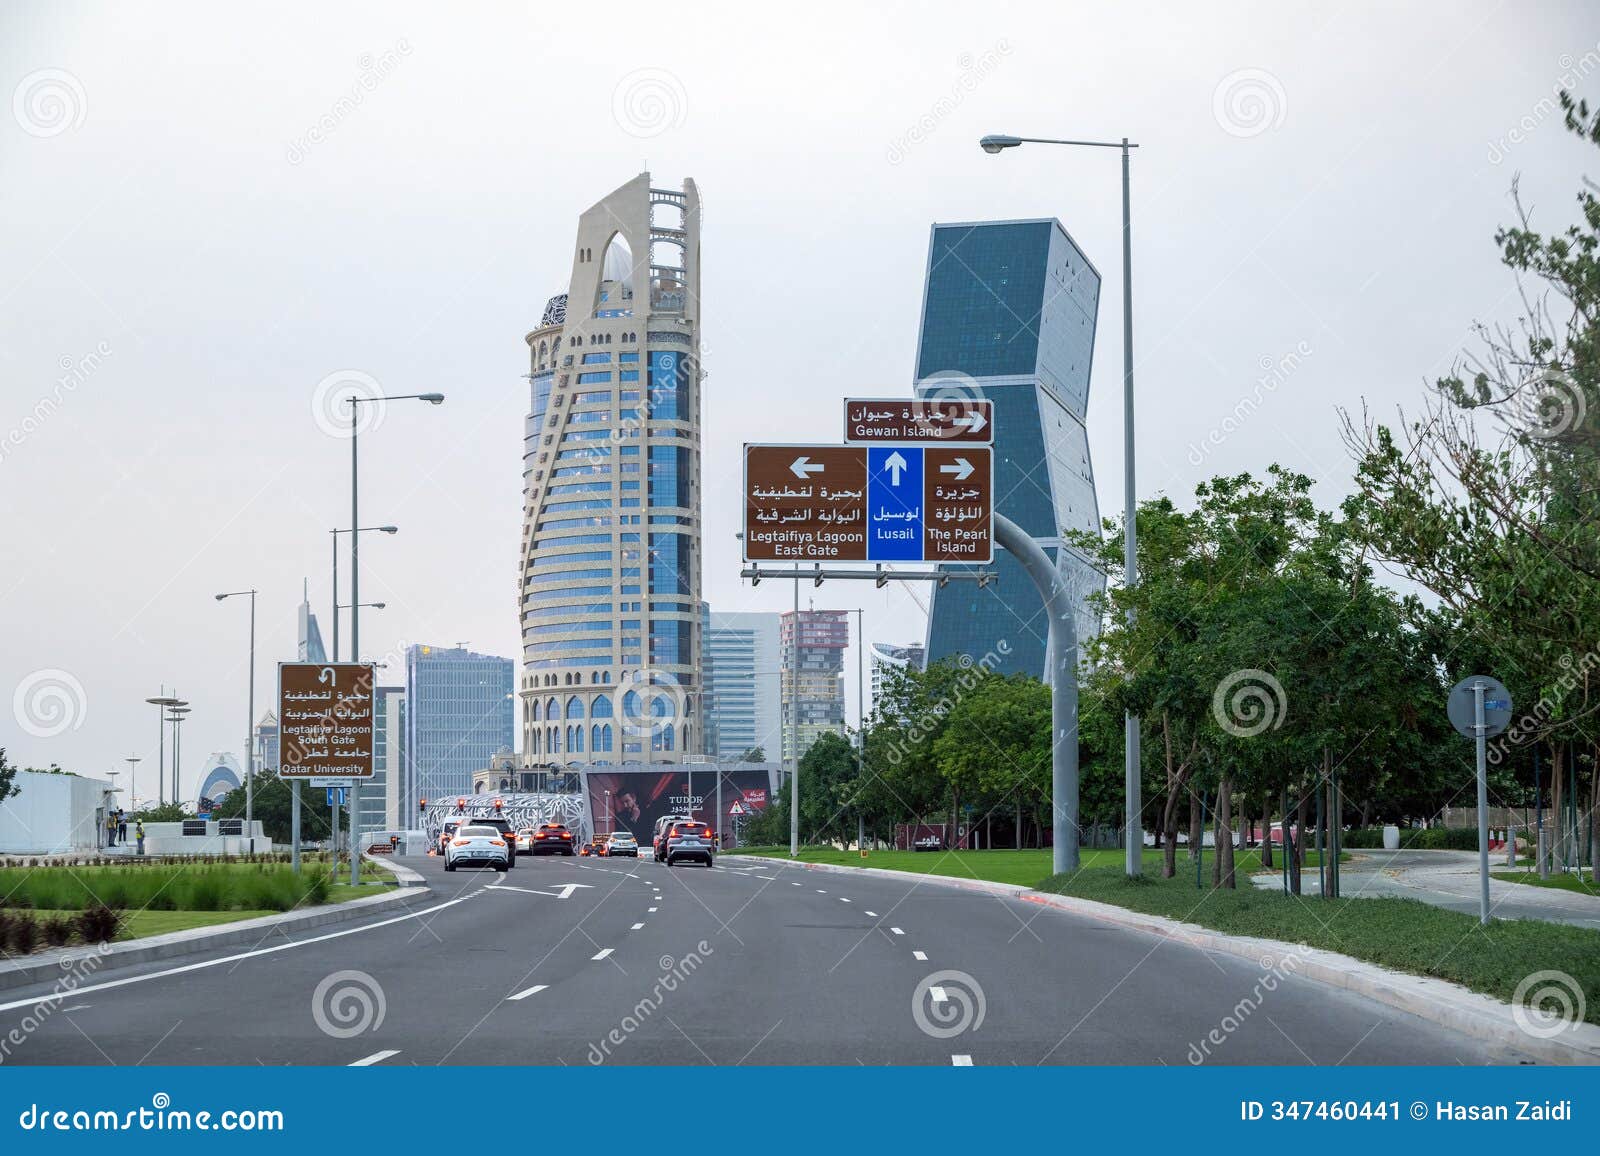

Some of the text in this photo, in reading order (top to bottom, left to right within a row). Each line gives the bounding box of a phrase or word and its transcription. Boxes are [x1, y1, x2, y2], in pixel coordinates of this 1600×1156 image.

[851, 407, 946, 422] جزيرة جيوان
[855, 425, 942, 437] Gewan Island
[752, 485, 863, 501] بحيرة لقطيفية
[935, 486, 981, 500] جزيرة
[756, 508, 861, 524] البوابة الشرقية
[873, 506, 919, 521] لوسيل
[935, 506, 982, 522] اللؤلؤة
[750, 530, 863, 544] Legtaifiya Lagoon
[877, 528, 915, 540] Lusail
[928, 528, 988, 540] The Pearl
[775, 544, 838, 556] East Gate
[937, 541, 976, 553] Island
[335, 725, 371, 736] Lagoon
[298, 735, 356, 745] South Gate
[303, 746, 371, 760] جامعة قطر
[282, 763, 364, 775] Qatar University
[669, 796, 703, 804] TUDOR
